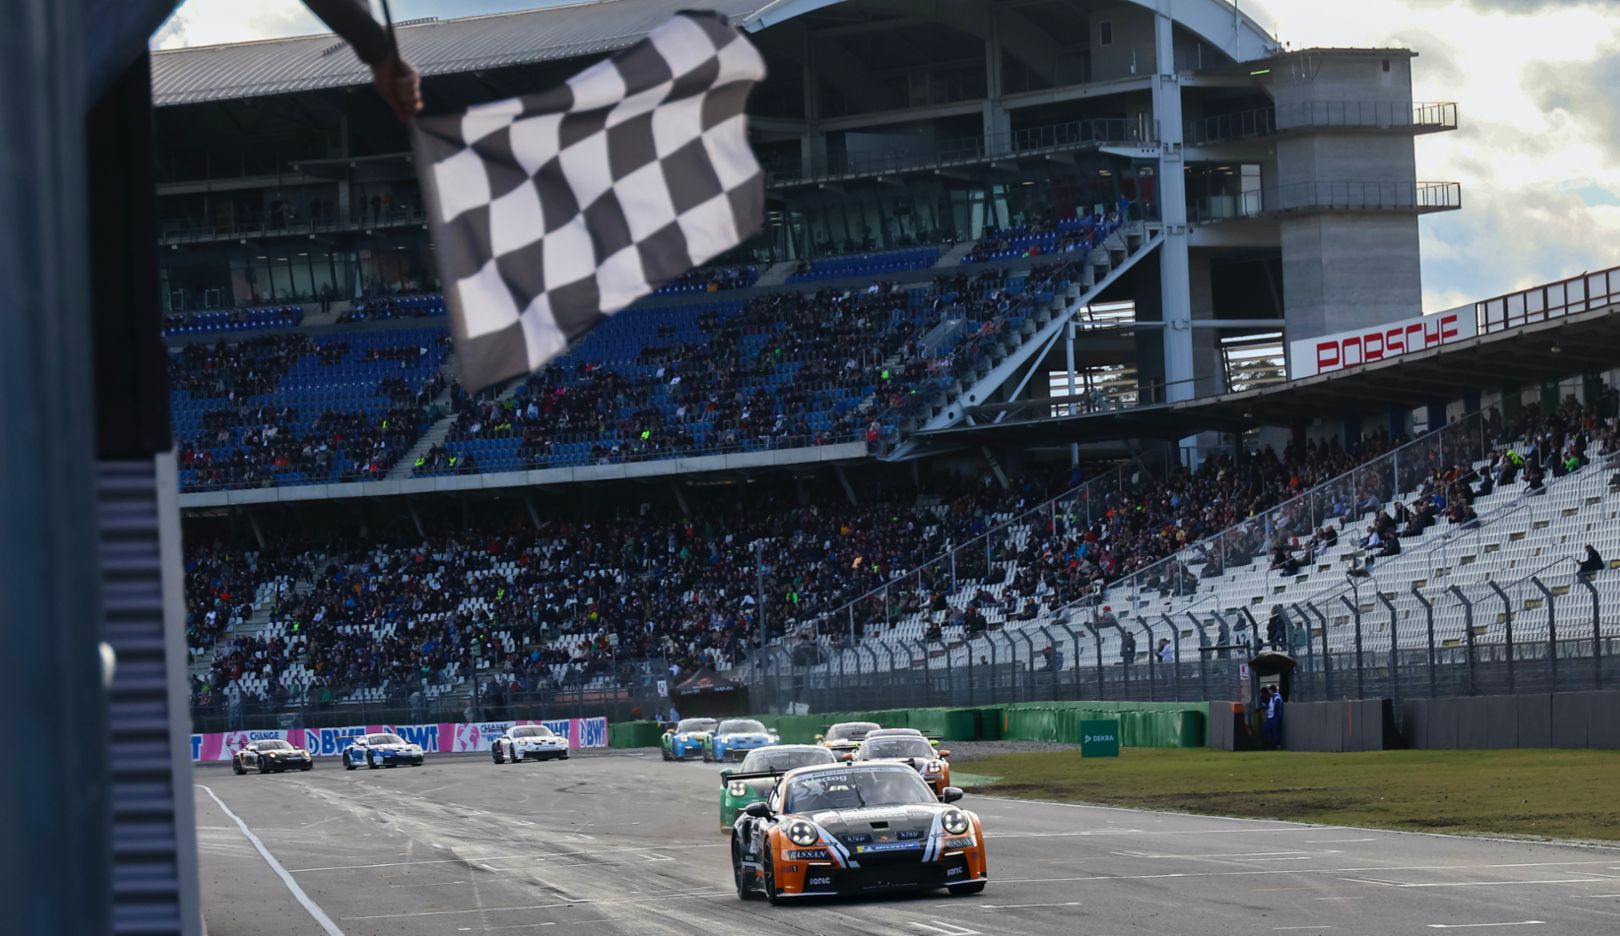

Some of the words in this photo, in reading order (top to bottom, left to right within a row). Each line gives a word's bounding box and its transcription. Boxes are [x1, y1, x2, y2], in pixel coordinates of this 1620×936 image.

[1316, 314, 1458, 375] PORSCHE
[250, 731, 280, 740] CHANGE
[587, 719, 605, 745] BWT
